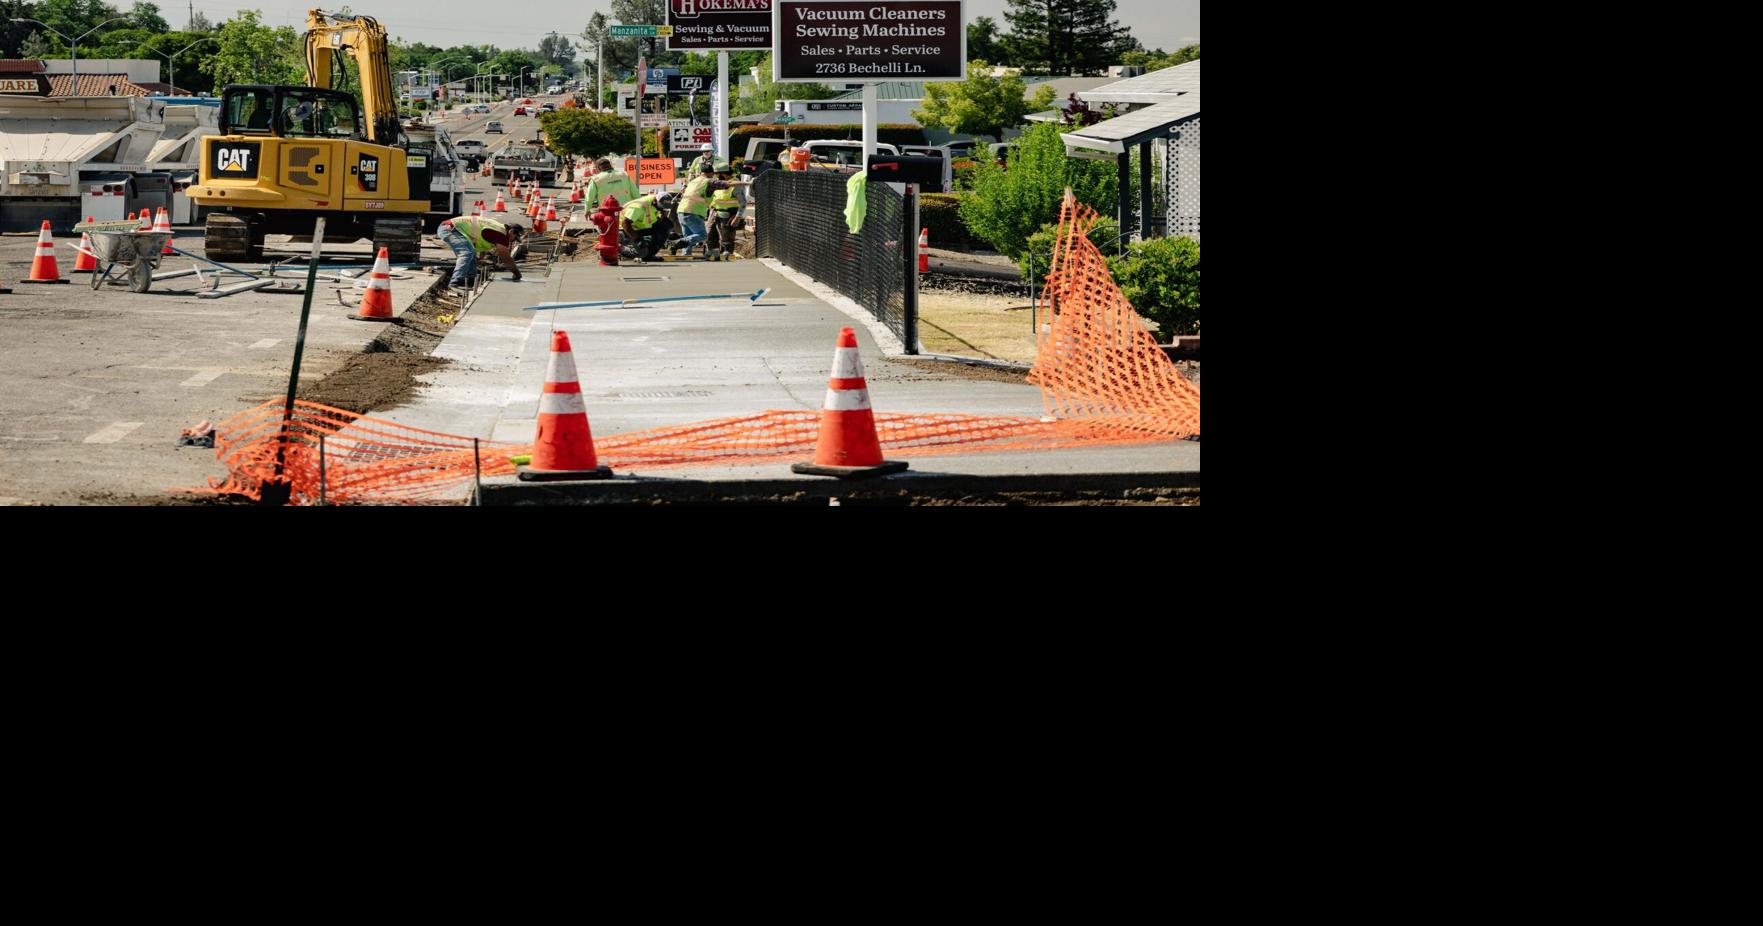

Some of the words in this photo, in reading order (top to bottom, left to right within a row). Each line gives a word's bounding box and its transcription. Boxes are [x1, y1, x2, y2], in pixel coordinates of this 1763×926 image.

[679, 0, 769, 15] HOKEMA'S
[795, 7, 865, 20] Vacuum
[869, 6, 946, 20] Cleaners
[611, 26, 648, 35] Manzanita
[675, 25, 714, 35] Sewing
[715, 25, 725, 33] &
[726, 24, 770, 33] Vacuum
[795, 24, 859, 39] Sewing
[862, 23, 946, 37] Machines
[734, 35, 764, 43] Service
[801, 44, 835, 56] Sales
[845, 44, 881, 56] Parts
[891, 44, 941, 55] Service
[815, 63, 846, 73] 2736
[849, 62, 901, 73] Bechelli
[905, 63, 926, 73] Ln.
[217, 148, 250, 171] CAT
[360, 159, 377, 172] CAT
[628, 163, 672, 171] BSINESS
